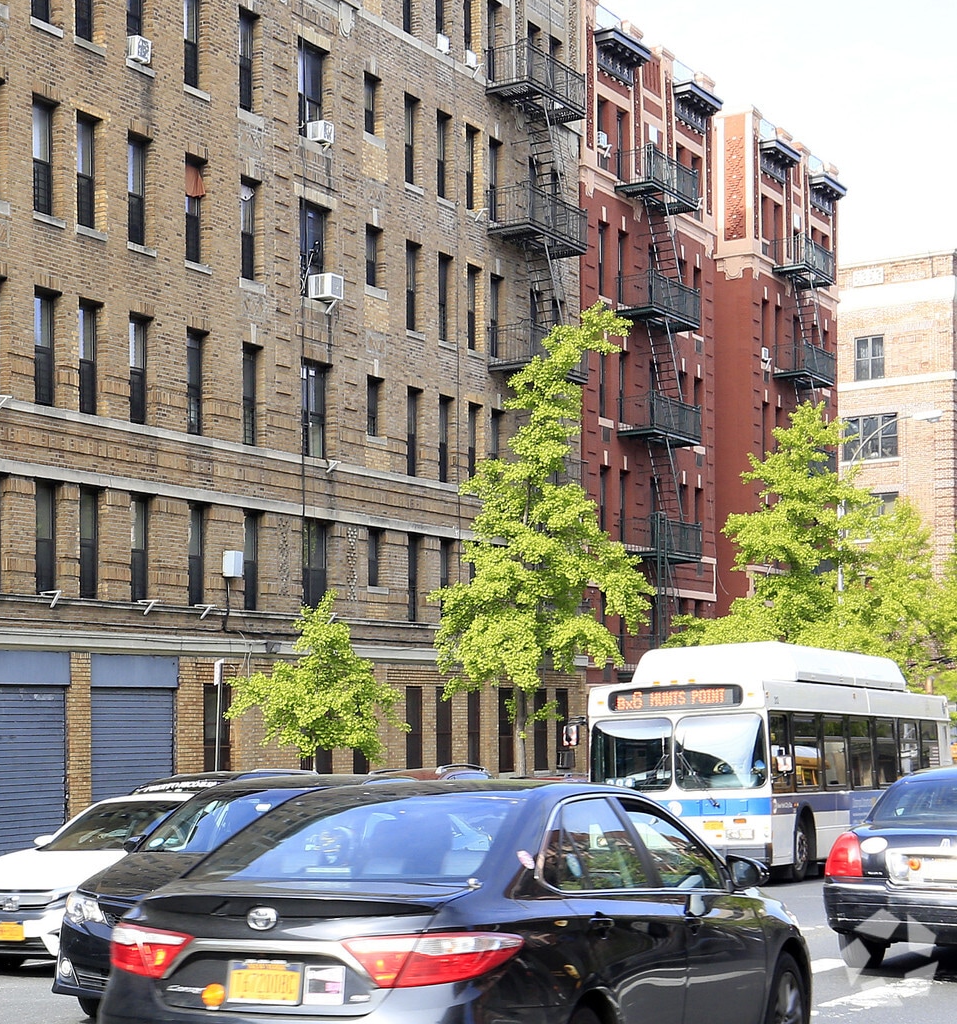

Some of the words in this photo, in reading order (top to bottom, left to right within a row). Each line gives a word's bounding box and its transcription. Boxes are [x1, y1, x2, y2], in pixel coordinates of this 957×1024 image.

[616, 691, 643, 711] Bx6
[649, 690, 686, 708] HUNTS
[690, 687, 726, 705] POINT
